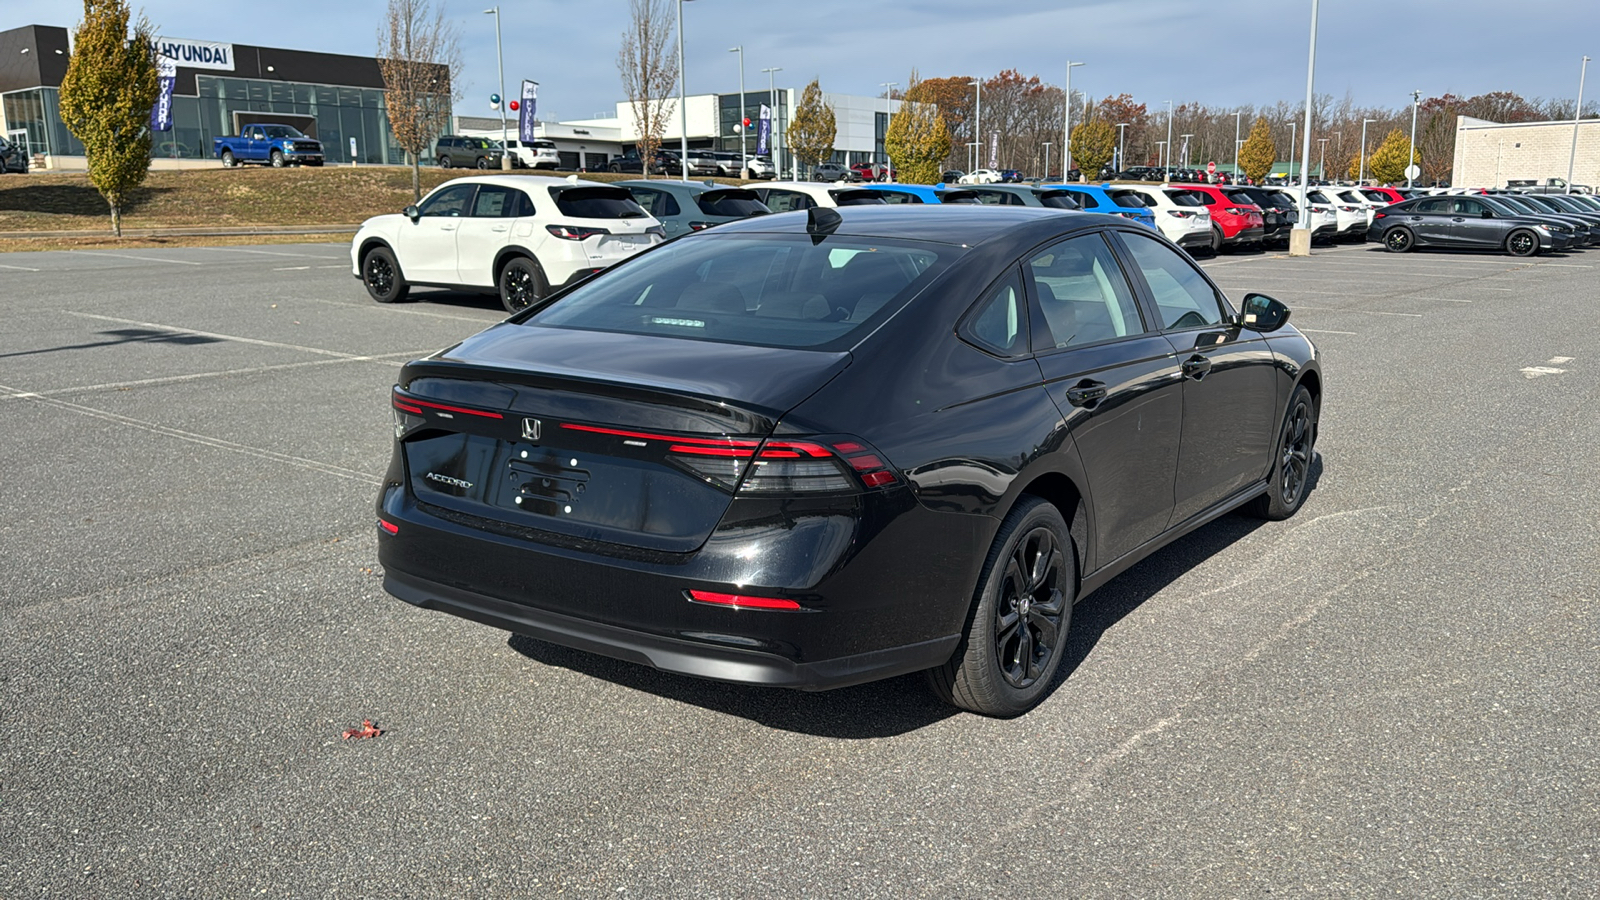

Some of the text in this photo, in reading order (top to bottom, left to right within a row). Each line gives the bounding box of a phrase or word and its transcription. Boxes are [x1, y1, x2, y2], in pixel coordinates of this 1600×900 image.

[162, 42, 227, 64] HYUNDAI
[158, 80, 169, 130] HYUNDAI
[426, 472, 473, 489] ACCORD
